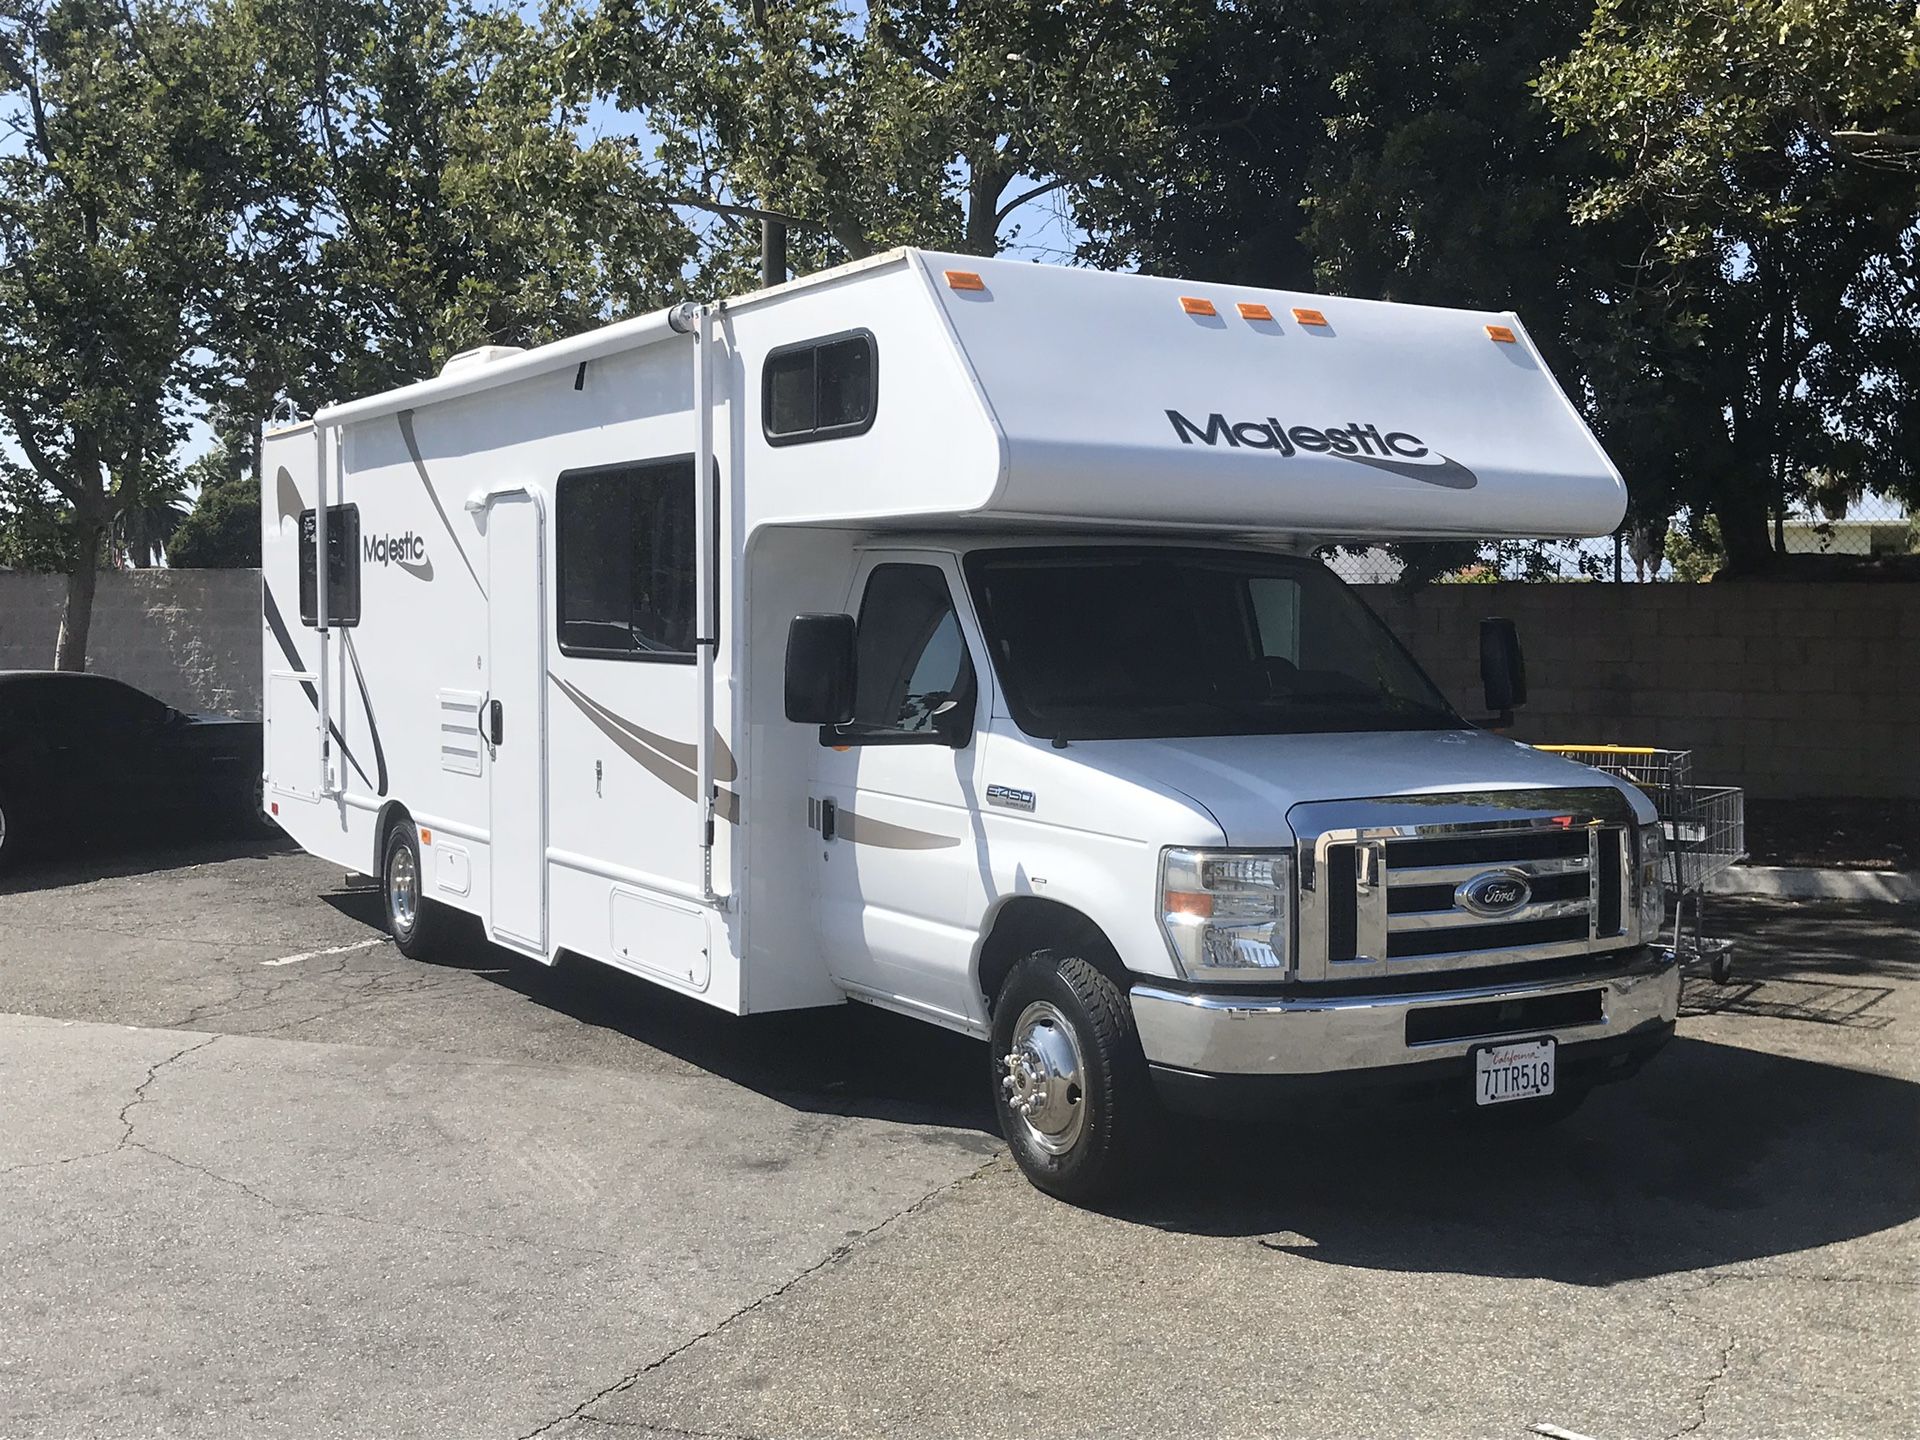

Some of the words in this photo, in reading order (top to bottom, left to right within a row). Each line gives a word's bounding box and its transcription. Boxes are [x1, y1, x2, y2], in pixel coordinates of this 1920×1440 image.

[1164, 409, 1429, 458] Majestic
[363, 531, 424, 567] Majestic
[1484, 884, 1516, 903] Ford
[1493, 1050, 1540, 1066] California
[1482, 1061, 1550, 1096] 7TTR518
